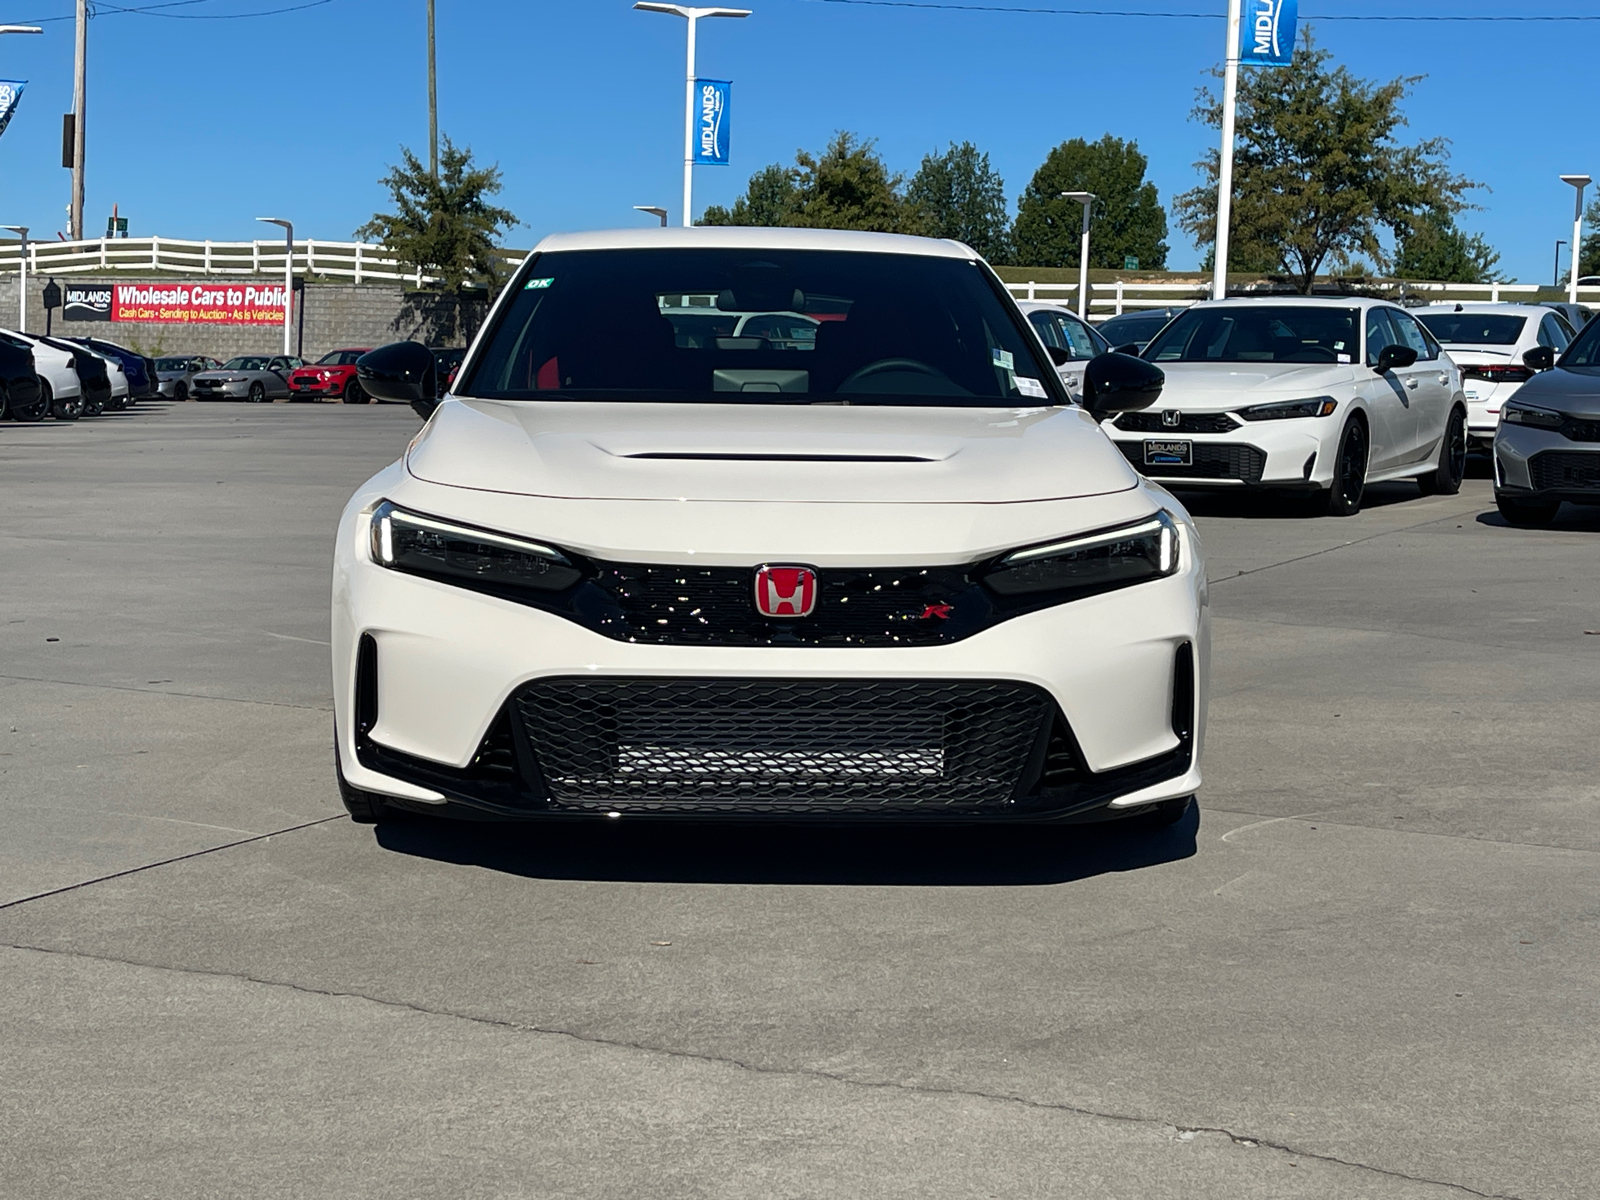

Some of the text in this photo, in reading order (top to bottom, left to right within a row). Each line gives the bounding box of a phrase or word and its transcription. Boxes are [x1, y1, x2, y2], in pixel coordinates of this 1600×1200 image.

[1253, 0, 1274, 53] MIDL
[702, 86, 714, 155] MIDLANDS
[527, 279, 552, 288] OK
[66, 291, 112, 303] MIDLANDS
[118, 286, 189, 305] Wholesale
[191, 286, 224, 306] Cars
[226, 288, 243, 306] to
[119, 307, 285, 321] Cash Cars Sending to Auction As Is Vehicles
